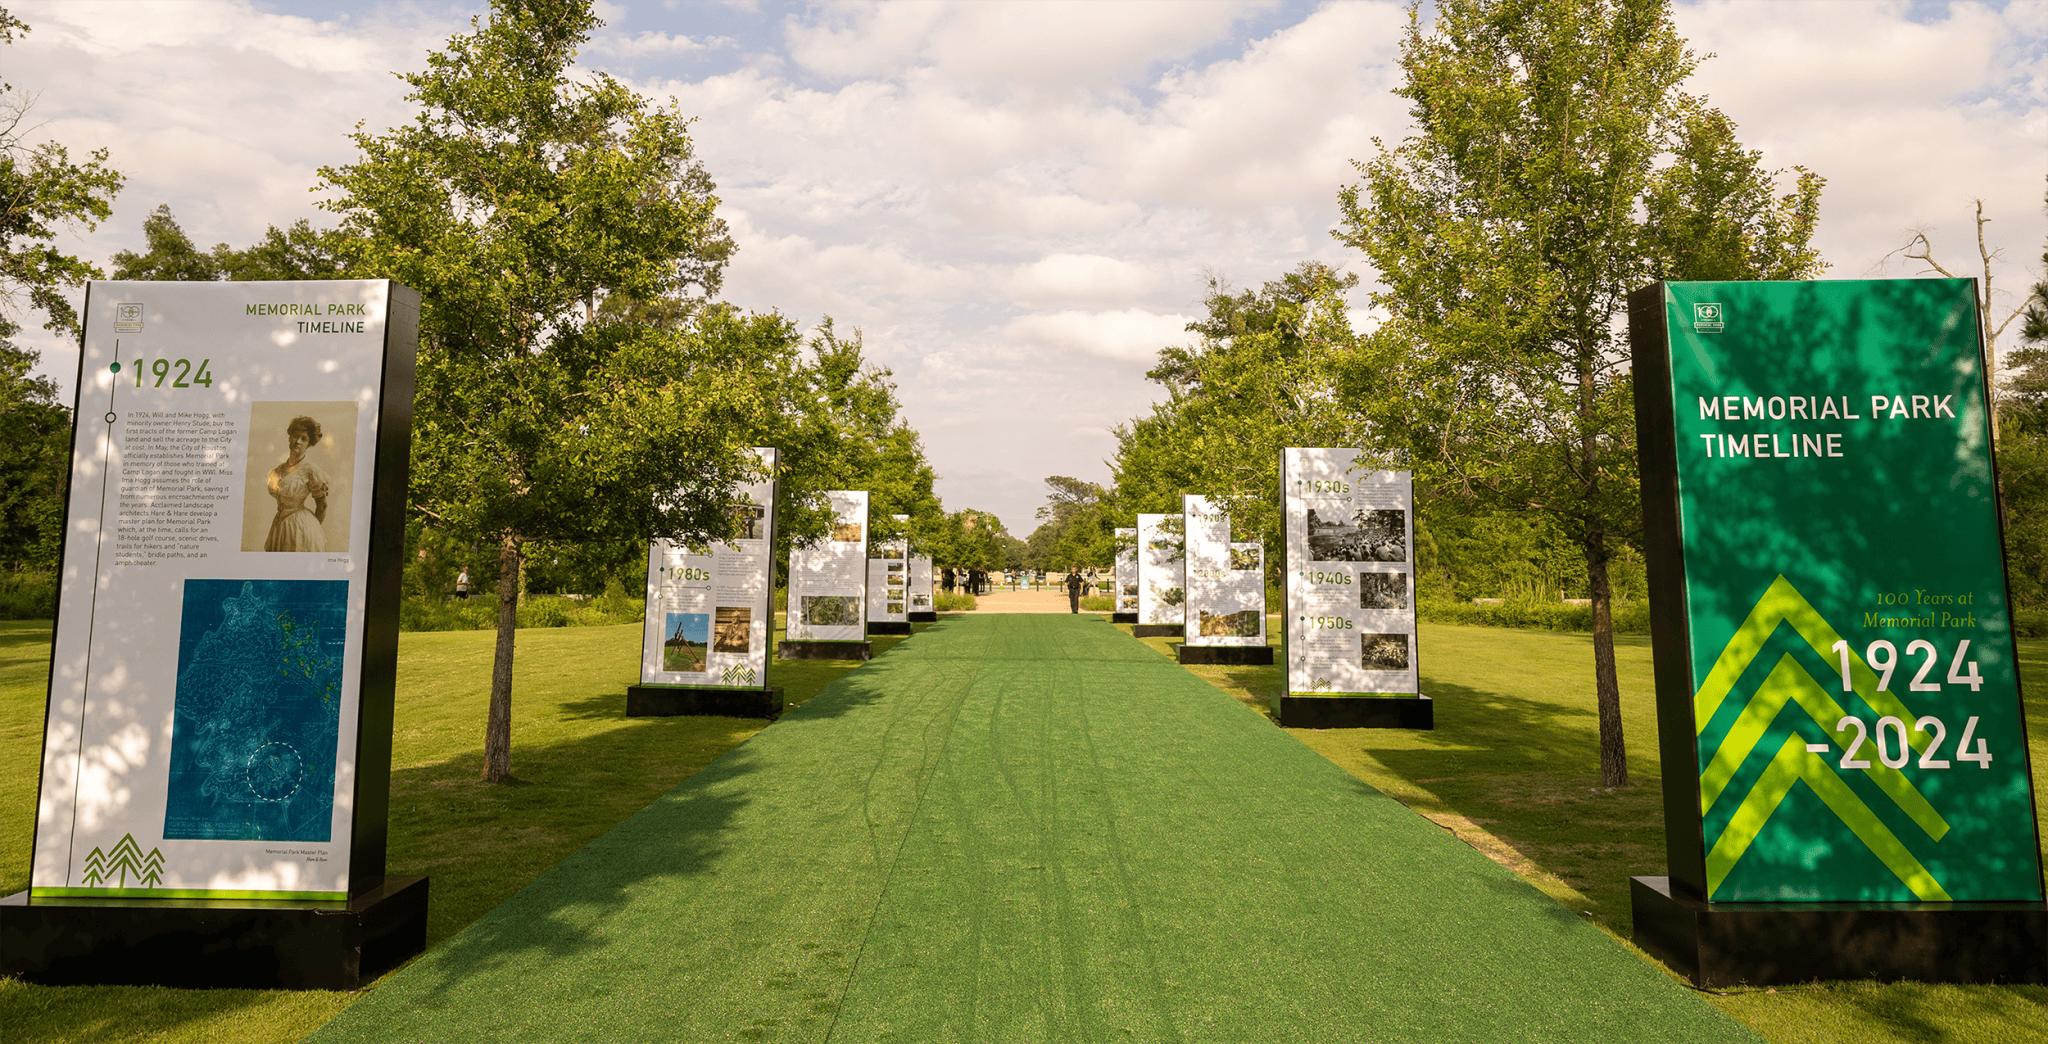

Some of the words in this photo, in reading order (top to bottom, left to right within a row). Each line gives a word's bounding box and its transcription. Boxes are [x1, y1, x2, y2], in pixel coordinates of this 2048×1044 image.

[246, 304, 322, 316] MEMORIAL
[328, 304, 366, 316] PARK
[297, 322, 364, 333] TIMELINE
[133, 358, 213, 388] 1924
[1699, 396, 1859, 420] MEMORIAL
[1872, 394, 1956, 419] PARK
[1700, 433, 1843, 458] TIMELINE
[1307, 480, 1350, 493] 1930s
[669, 568, 710, 580] 1980s
[1198, 570, 1226, 578] 2000s
[1309, 572, 1352, 585] 1940s
[1877, 593, 1908, 605] 100
[1915, 589, 1953, 605] Years
[1958, 592, 1973, 604] at
[1310, 616, 1353, 629] 1950s
[1863, 612, 1935, 628] Memorial
[1941, 612, 1976, 628] Park
[1832, 639, 1984, 692] 1924
[1806, 715, 1993, 769] -2024
